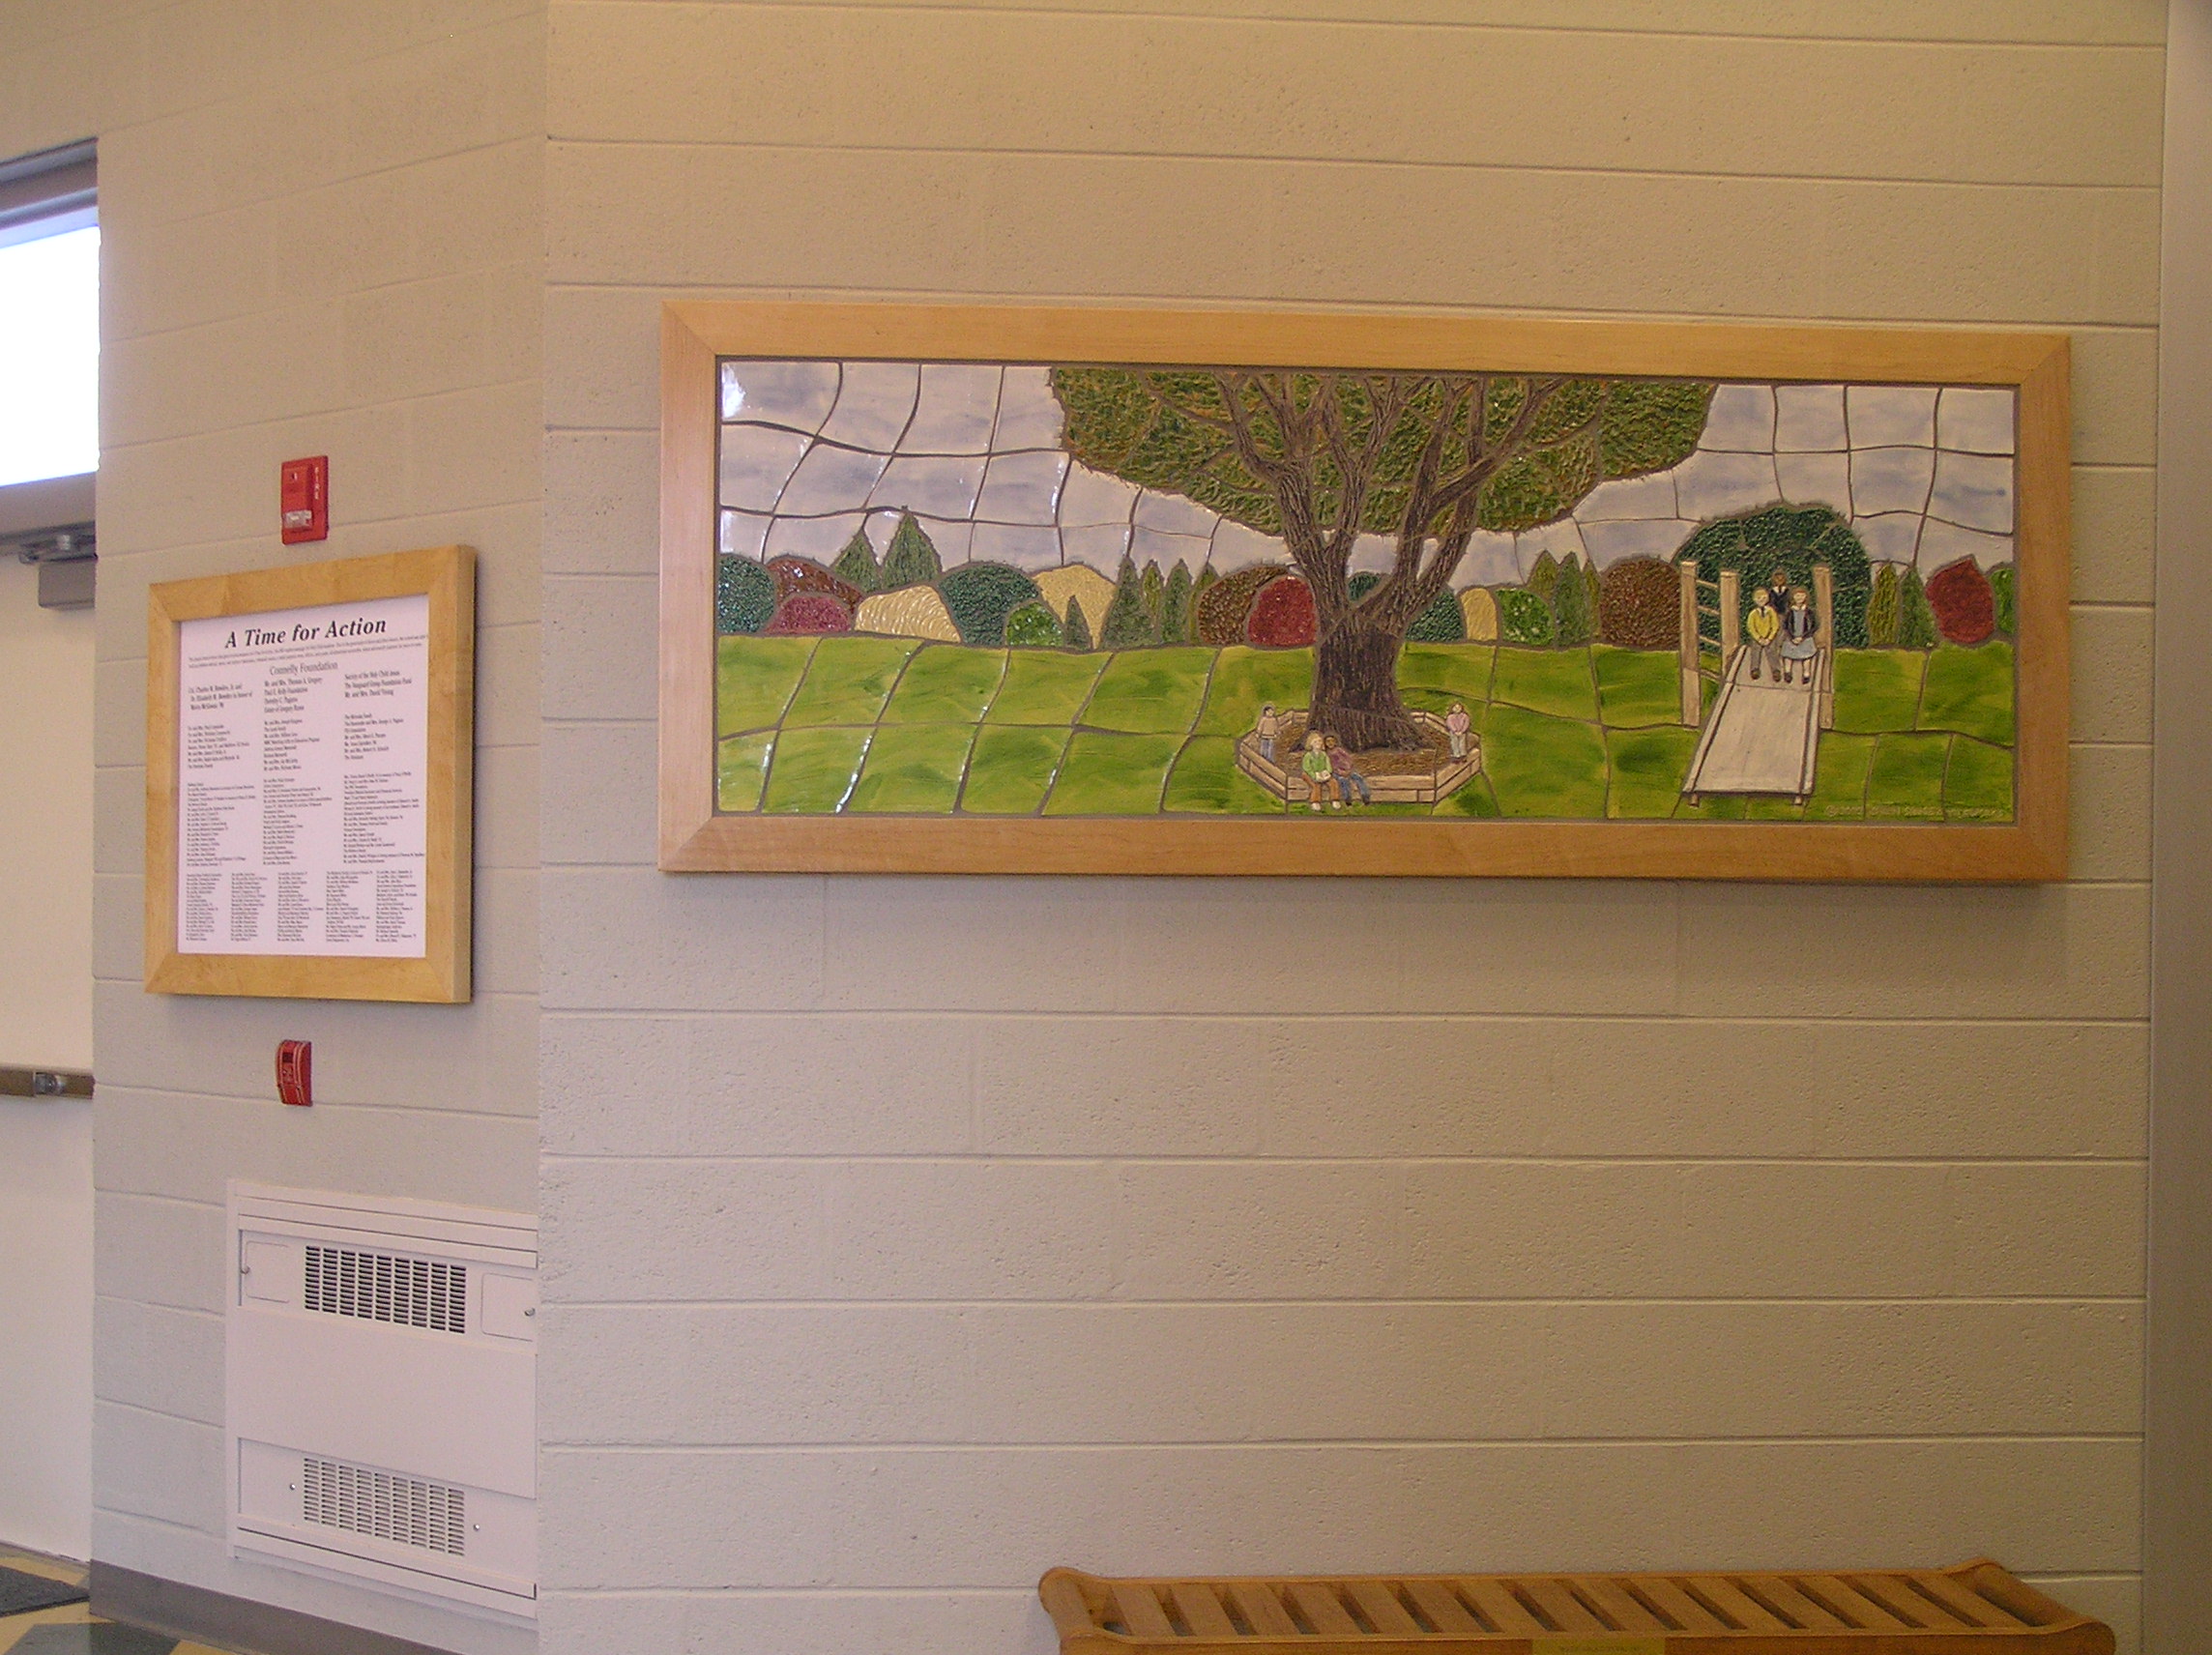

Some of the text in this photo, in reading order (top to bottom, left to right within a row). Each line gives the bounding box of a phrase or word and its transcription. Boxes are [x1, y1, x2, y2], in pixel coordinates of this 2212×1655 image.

[224, 618, 387, 649] A Time for Action
[300, 661, 338, 673] Foundation
